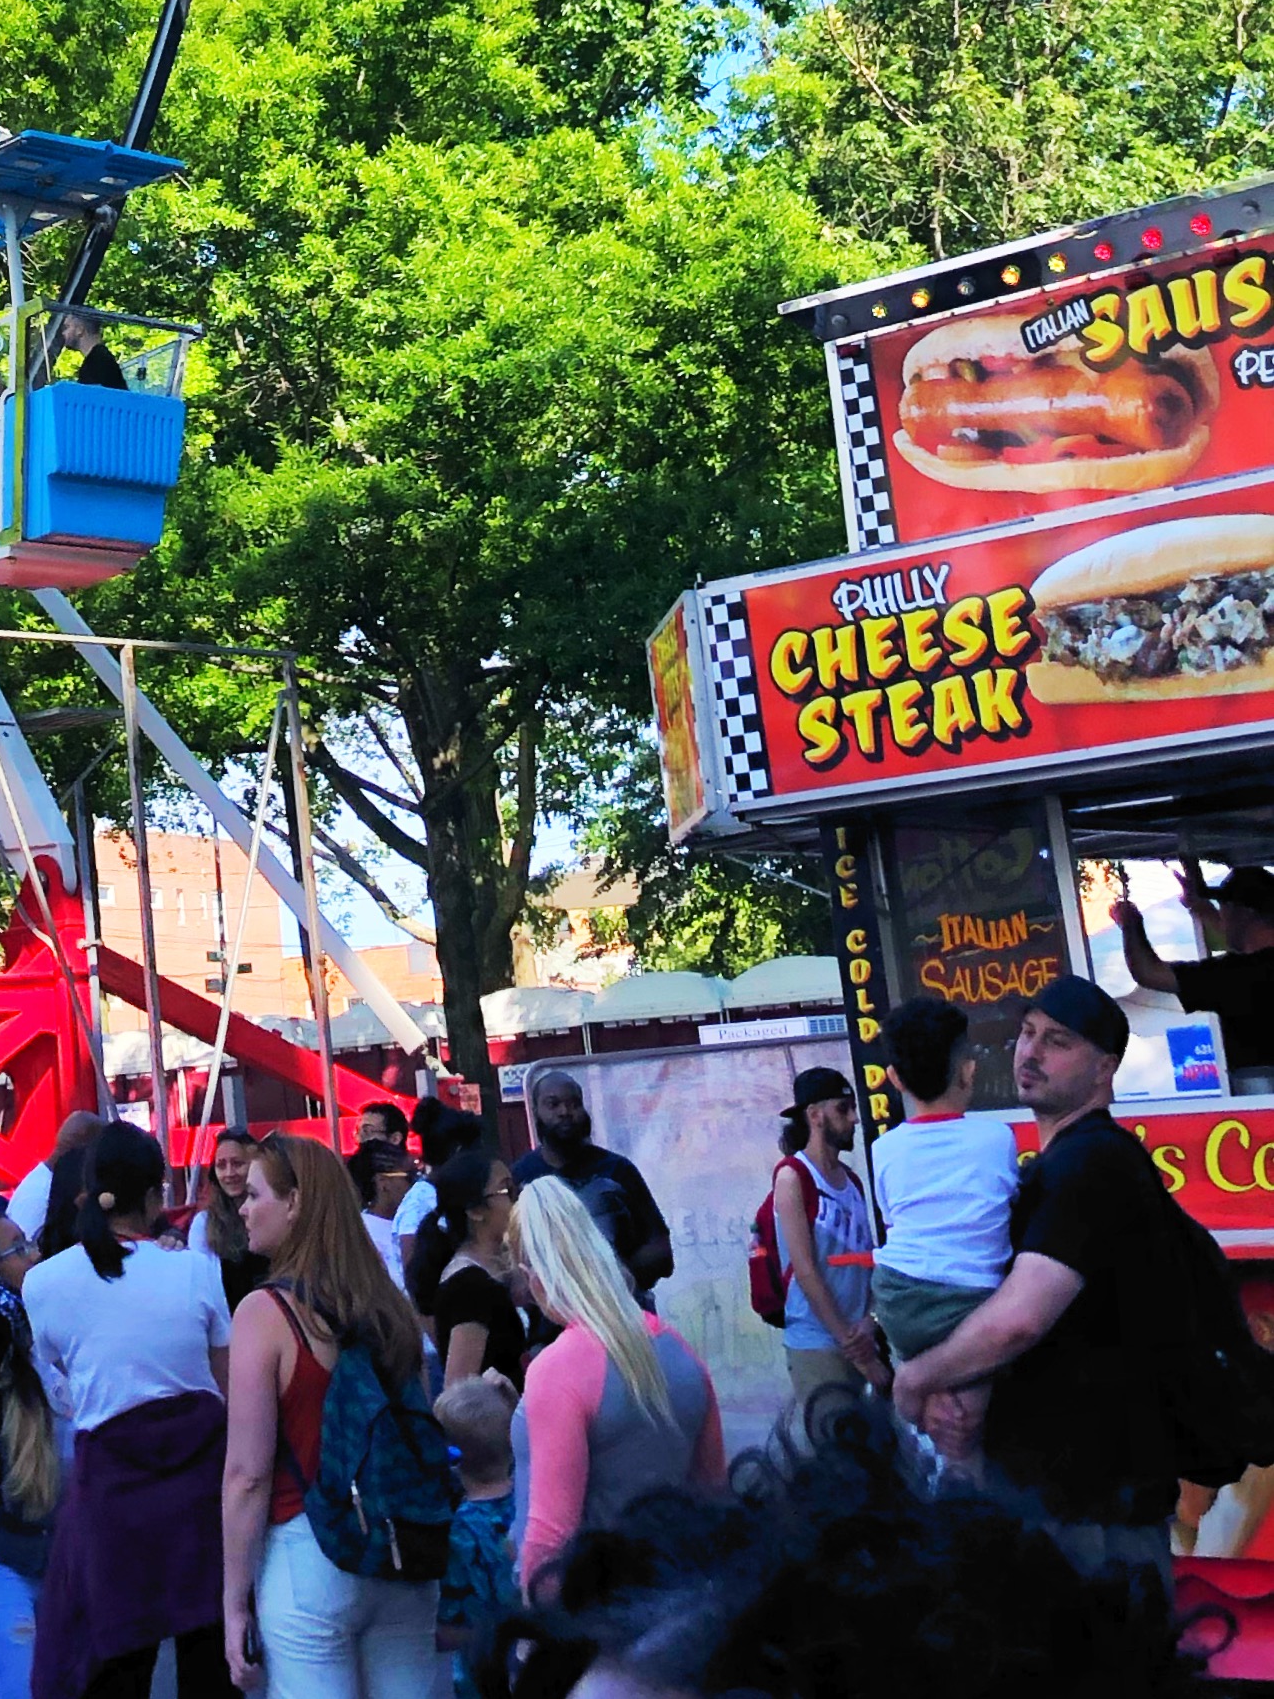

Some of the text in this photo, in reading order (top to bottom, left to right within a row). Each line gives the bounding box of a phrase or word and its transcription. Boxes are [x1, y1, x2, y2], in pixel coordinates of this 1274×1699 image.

[1025, 299, 1092, 348] ITALIAN
[832, 563, 949, 621] PHILLY
[771, 587, 1032, 696] CHEESE
[798, 668, 1024, 764] STEAK
[835, 827, 859, 908] ICE
[938, 909, 1029, 952] ITALIAN
[846, 929, 881, 1044] COLD
[921, 957, 1059, 1003] SAUSAGE
[718, 1024, 788, 1040] Packaged
